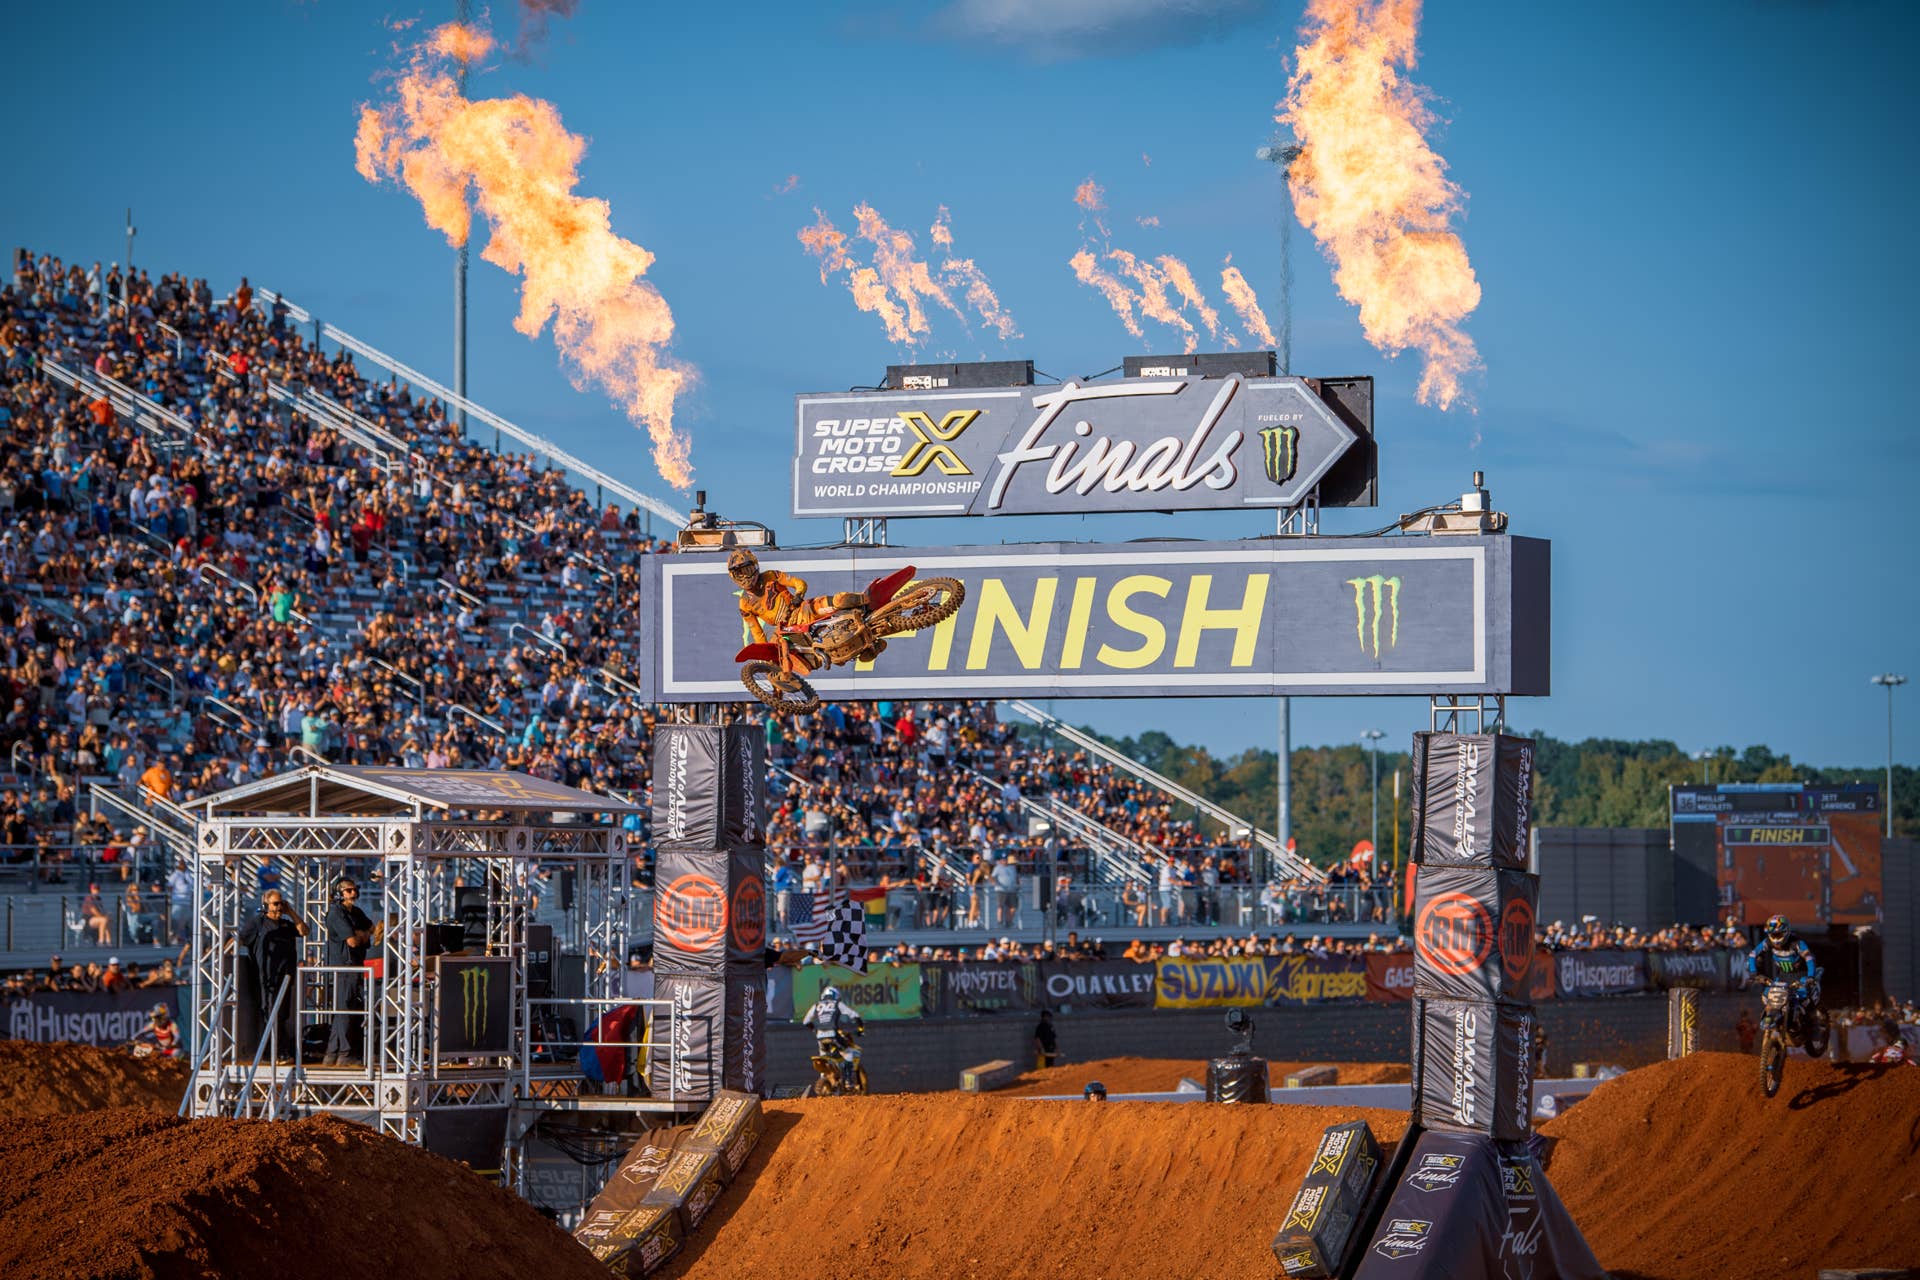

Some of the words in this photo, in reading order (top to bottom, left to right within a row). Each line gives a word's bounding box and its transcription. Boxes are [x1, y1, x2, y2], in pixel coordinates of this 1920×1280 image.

[813, 418, 905, 437] SUPER
[1292, 413, 1303, 421] BY
[818, 436, 901, 455] MOTO
[988, 378, 1244, 509] Finals
[812, 455, 902, 474] CROSS
[814, 484, 865, 498] WORLD
[869, 481, 982, 496] CHAMPIONSHIP
[855, 572, 1270, 671] INISH
[669, 733, 679, 790] MOUNTAIN
[1456, 742, 1466, 801] MOUNTAIN
[667, 793, 676, 825] ROCKY
[1866, 795, 1875, 808] 2
[1453, 802, 1464, 839] ROCKY
[1750, 828, 1804, 843] FINISH
[948, 967, 1017, 993] MONSTER
[1076, 973, 1153, 995] OAKLEY
[1161, 963, 1265, 1000] SUZUKI
[1293, 966, 1367, 1004] alpinestars
[1576, 960, 1635, 990] Husqvarna
[1453, 1010, 1464, 1070] MOUNTAIN
[1452, 1071, 1462, 1107] ROCKY
[1406, 1167, 1461, 1183] Finals
[1373, 1233, 1428, 1250] Finals
